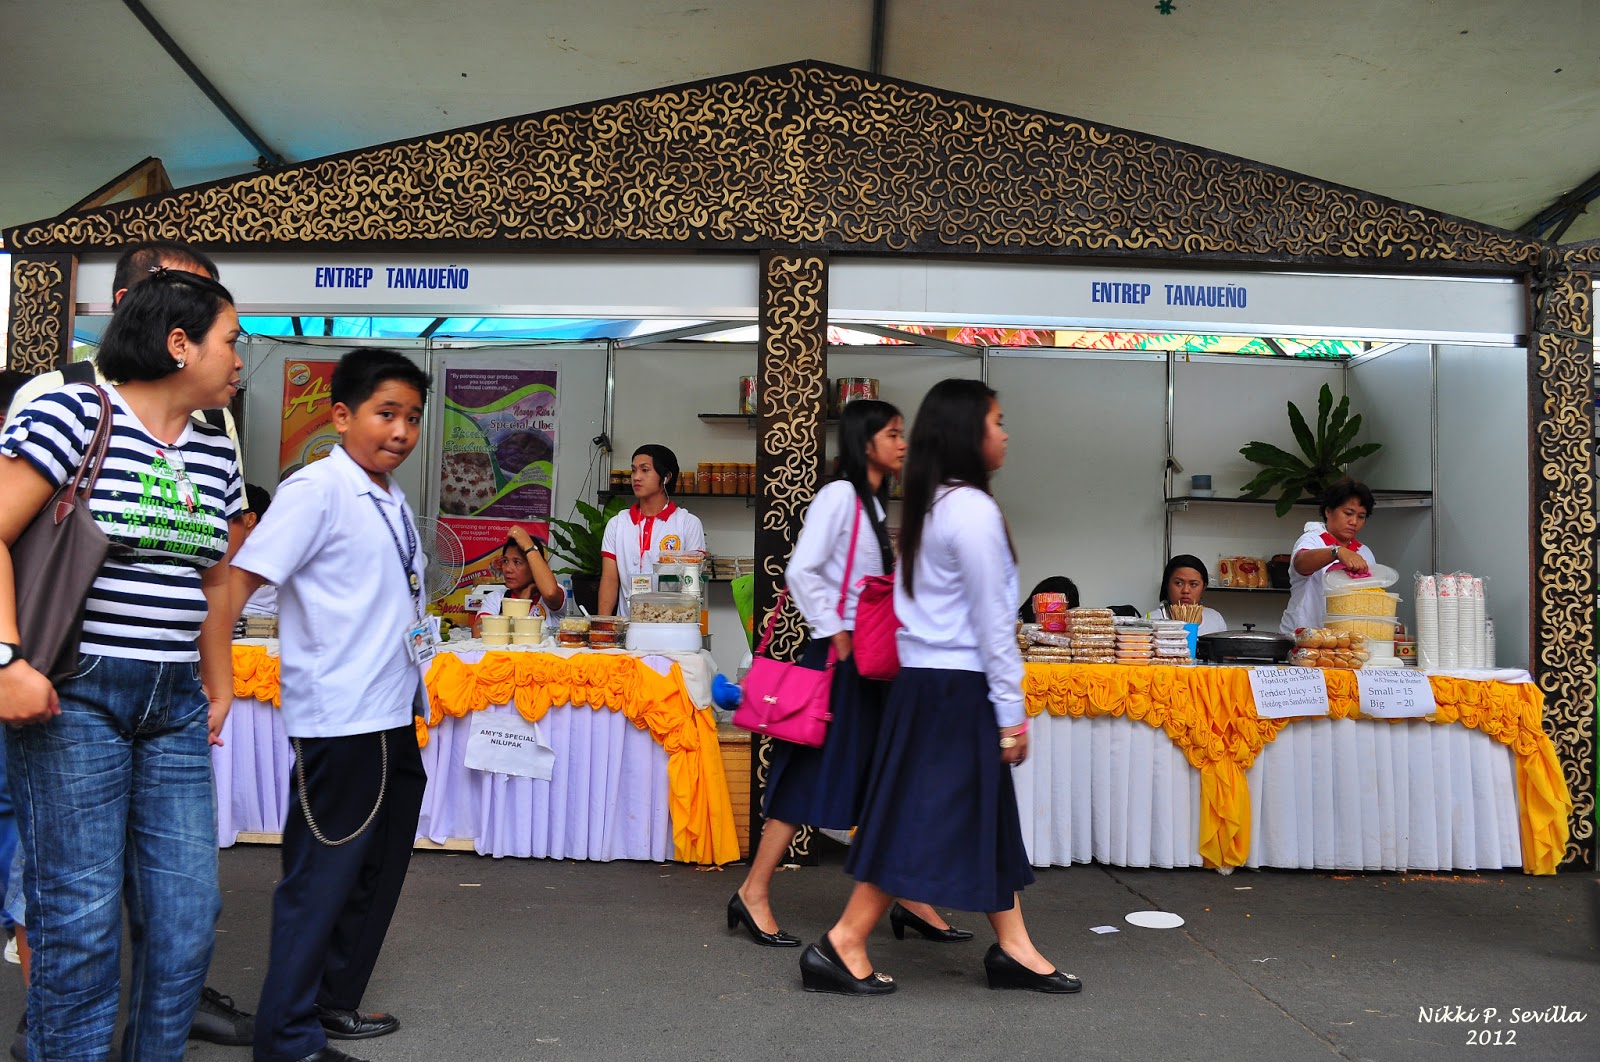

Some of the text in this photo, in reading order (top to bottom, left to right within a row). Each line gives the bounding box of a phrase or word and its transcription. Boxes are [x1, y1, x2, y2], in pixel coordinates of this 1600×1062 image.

[315, 264, 469, 289] ENTREP TANAUEÑO
[1091, 281, 1247, 309] ENTREP TANAUEÑO
[490, 419, 554, 431] Special Ube
[139, 497, 167, 512] WILL
[122, 507, 215, 535] GET TO HEAVEN
[126, 520, 213, 547] IF YOU BREAK
[138, 535, 200, 556] MY HEART
[436, 598, 465, 615] Specia
[1256, 667, 1320, 678] PUREFOODS
[1360, 669, 1425, 678] JAPANESE CORN
[1261, 677, 1288, 685] Hotdog
[1259, 688, 1287, 698] Tender
[1287, 687, 1307, 697] Juicy
[1313, 685, 1322, 694] 15
[1368, 687, 1394, 696] Small
[1403, 687, 1413, 695] 15
[1261, 700, 1282, 709] Hotdog
[1370, 699, 1385, 709] Big
[1404, 699, 1414, 707] 20
[480, 729, 535, 743] AMY'S SPECIAL
[490, 738, 522, 749] NILUPAK
